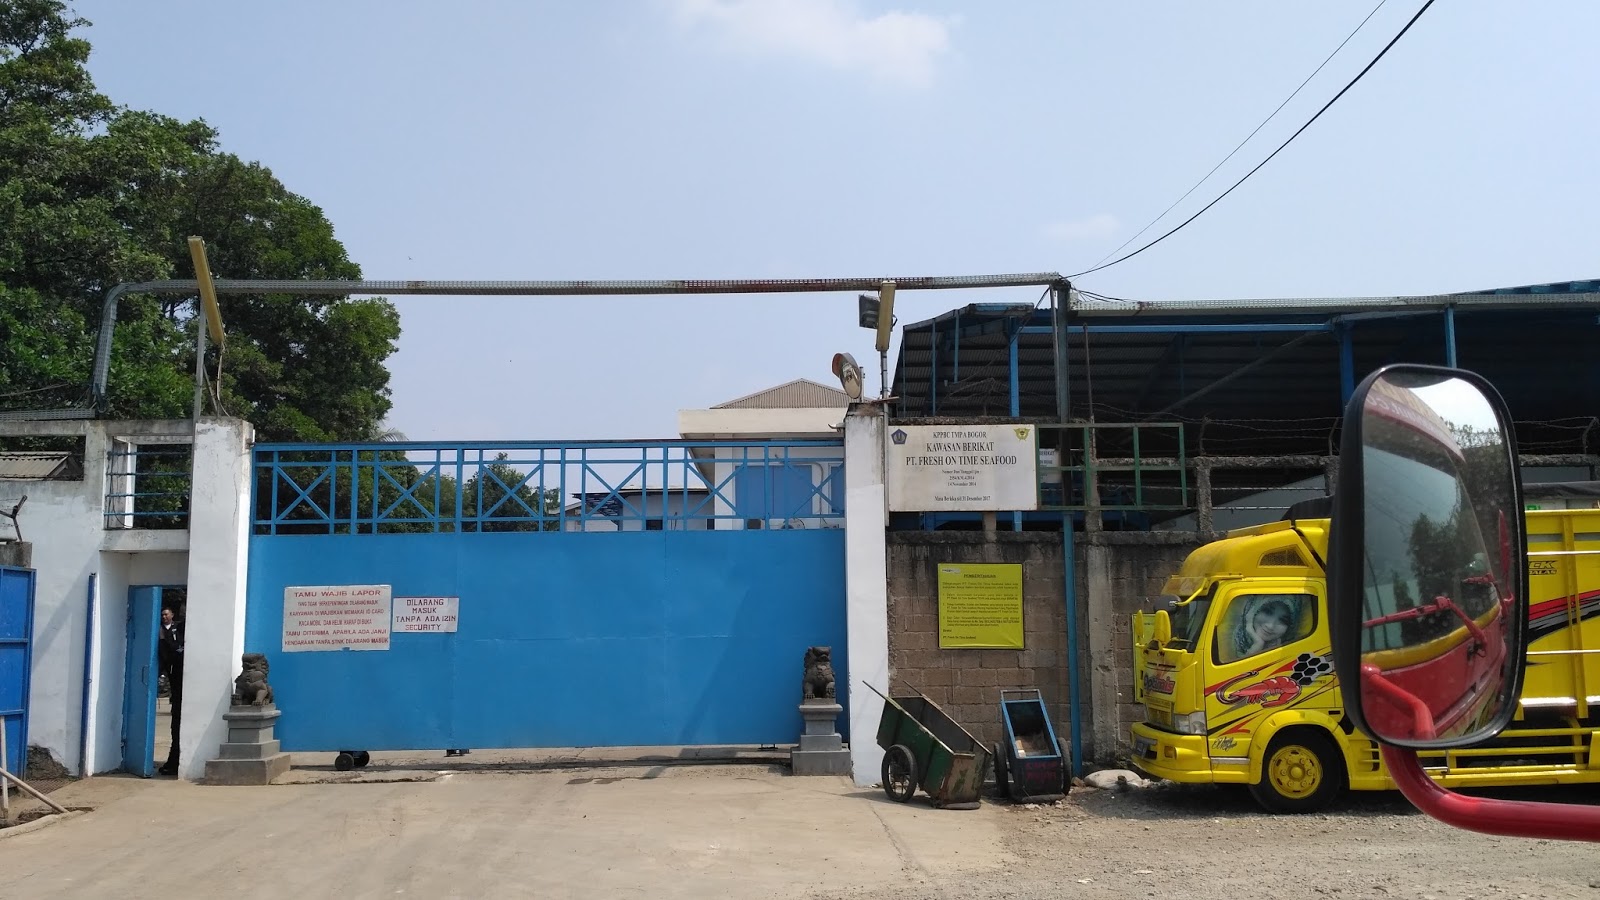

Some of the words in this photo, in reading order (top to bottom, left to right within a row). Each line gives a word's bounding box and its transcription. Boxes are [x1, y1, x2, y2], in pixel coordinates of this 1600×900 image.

[926, 442, 961, 452] KAWASAN
[962, 442, 994, 452] BERIKAT
[906, 456, 916, 466] PT.
[918, 456, 944, 466] FRESH
[946, 456, 957, 465] ON
[959, 456, 978, 465] TIME
[980, 456, 1017, 464] SEAFOOD
